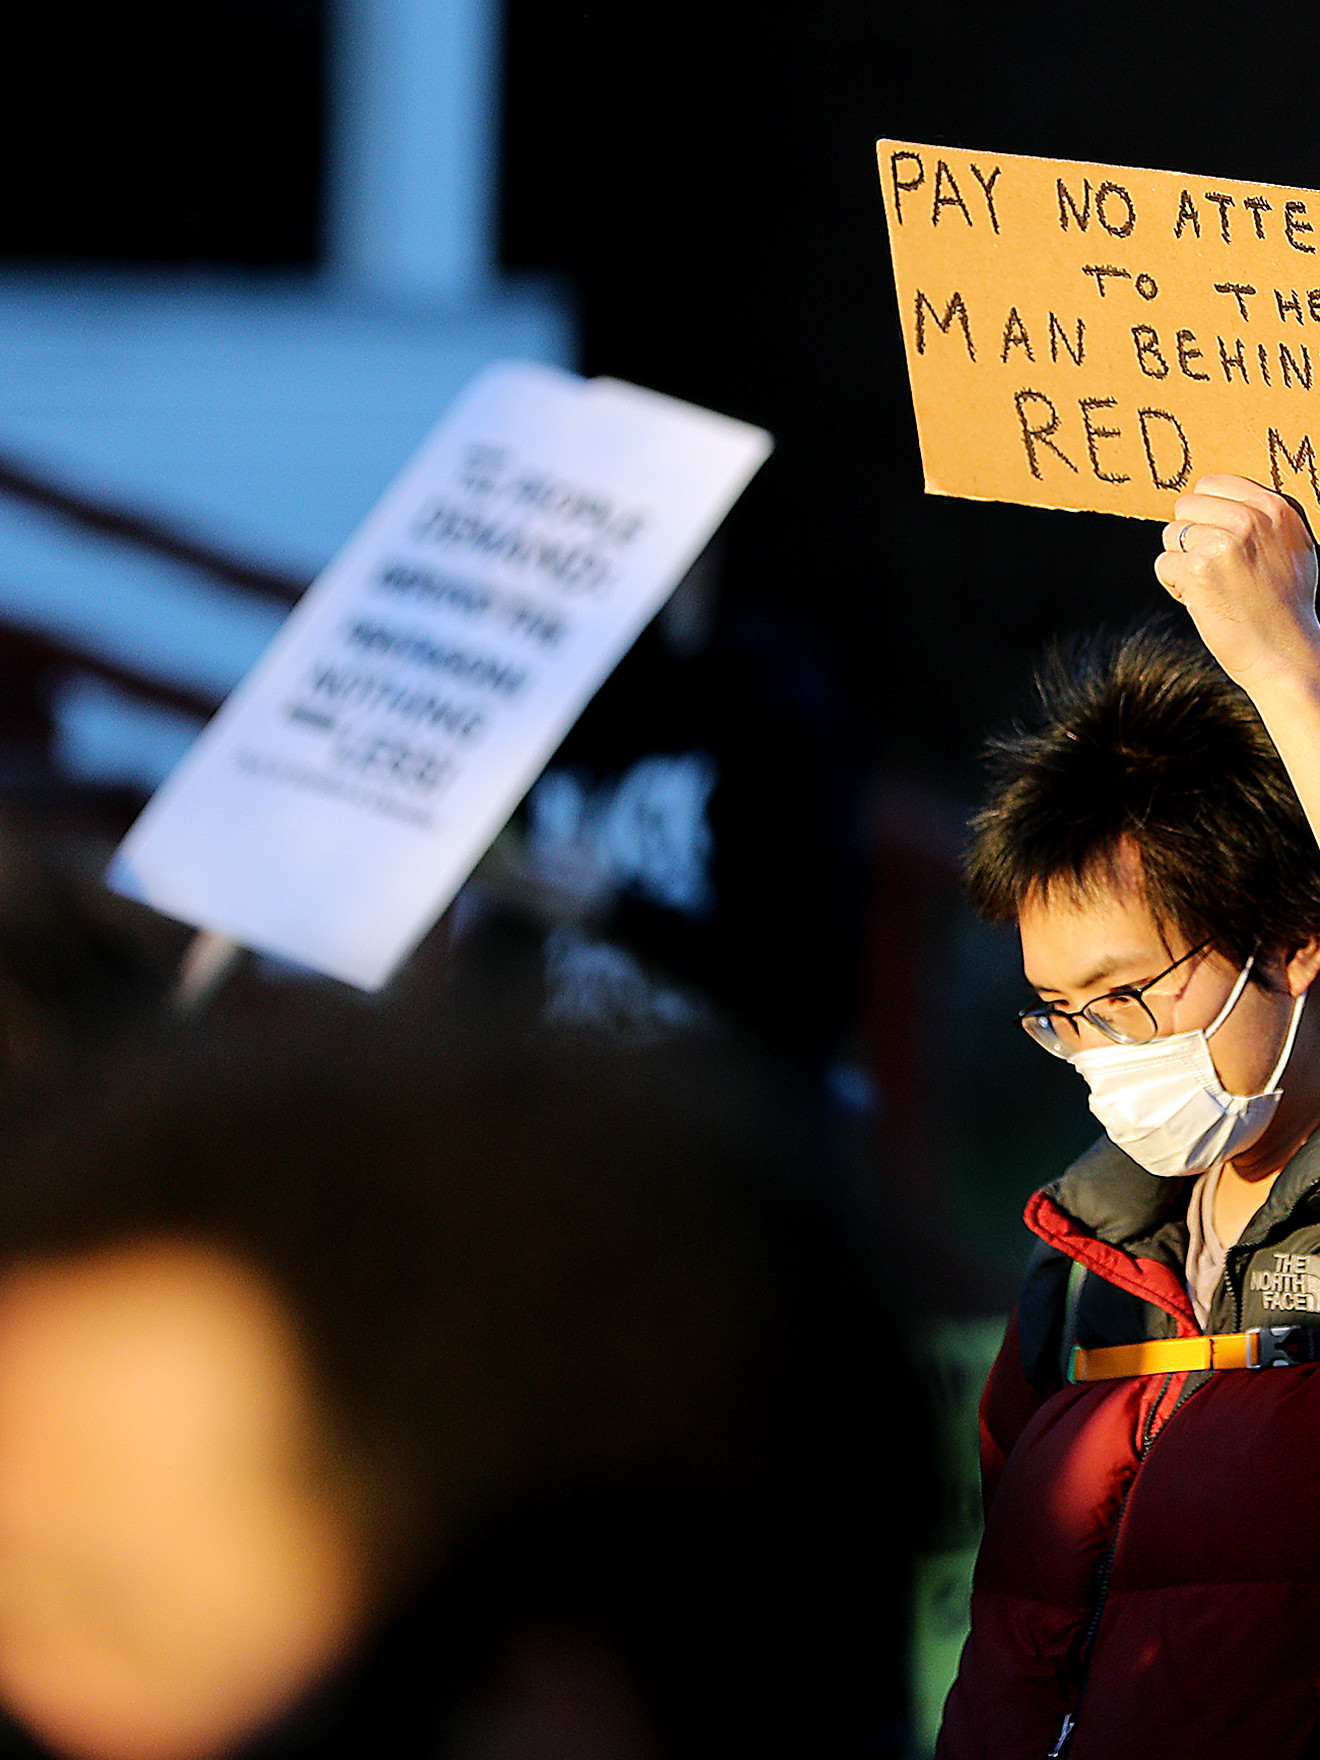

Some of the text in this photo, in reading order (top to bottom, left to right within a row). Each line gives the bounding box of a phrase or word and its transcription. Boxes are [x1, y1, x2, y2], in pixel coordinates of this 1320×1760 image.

[891, 151, 1001, 234] PAY
[1057, 179, 1135, 238] NO
[1082, 265, 1158, 300] TO
[915, 290, 1085, 366] MAN
[1015, 388, 1192, 492] RED
[1275, 1253, 1310, 1272] THE
[1251, 1272, 1306, 1293] NORTH
[1263, 1292, 1308, 1310] FACE
